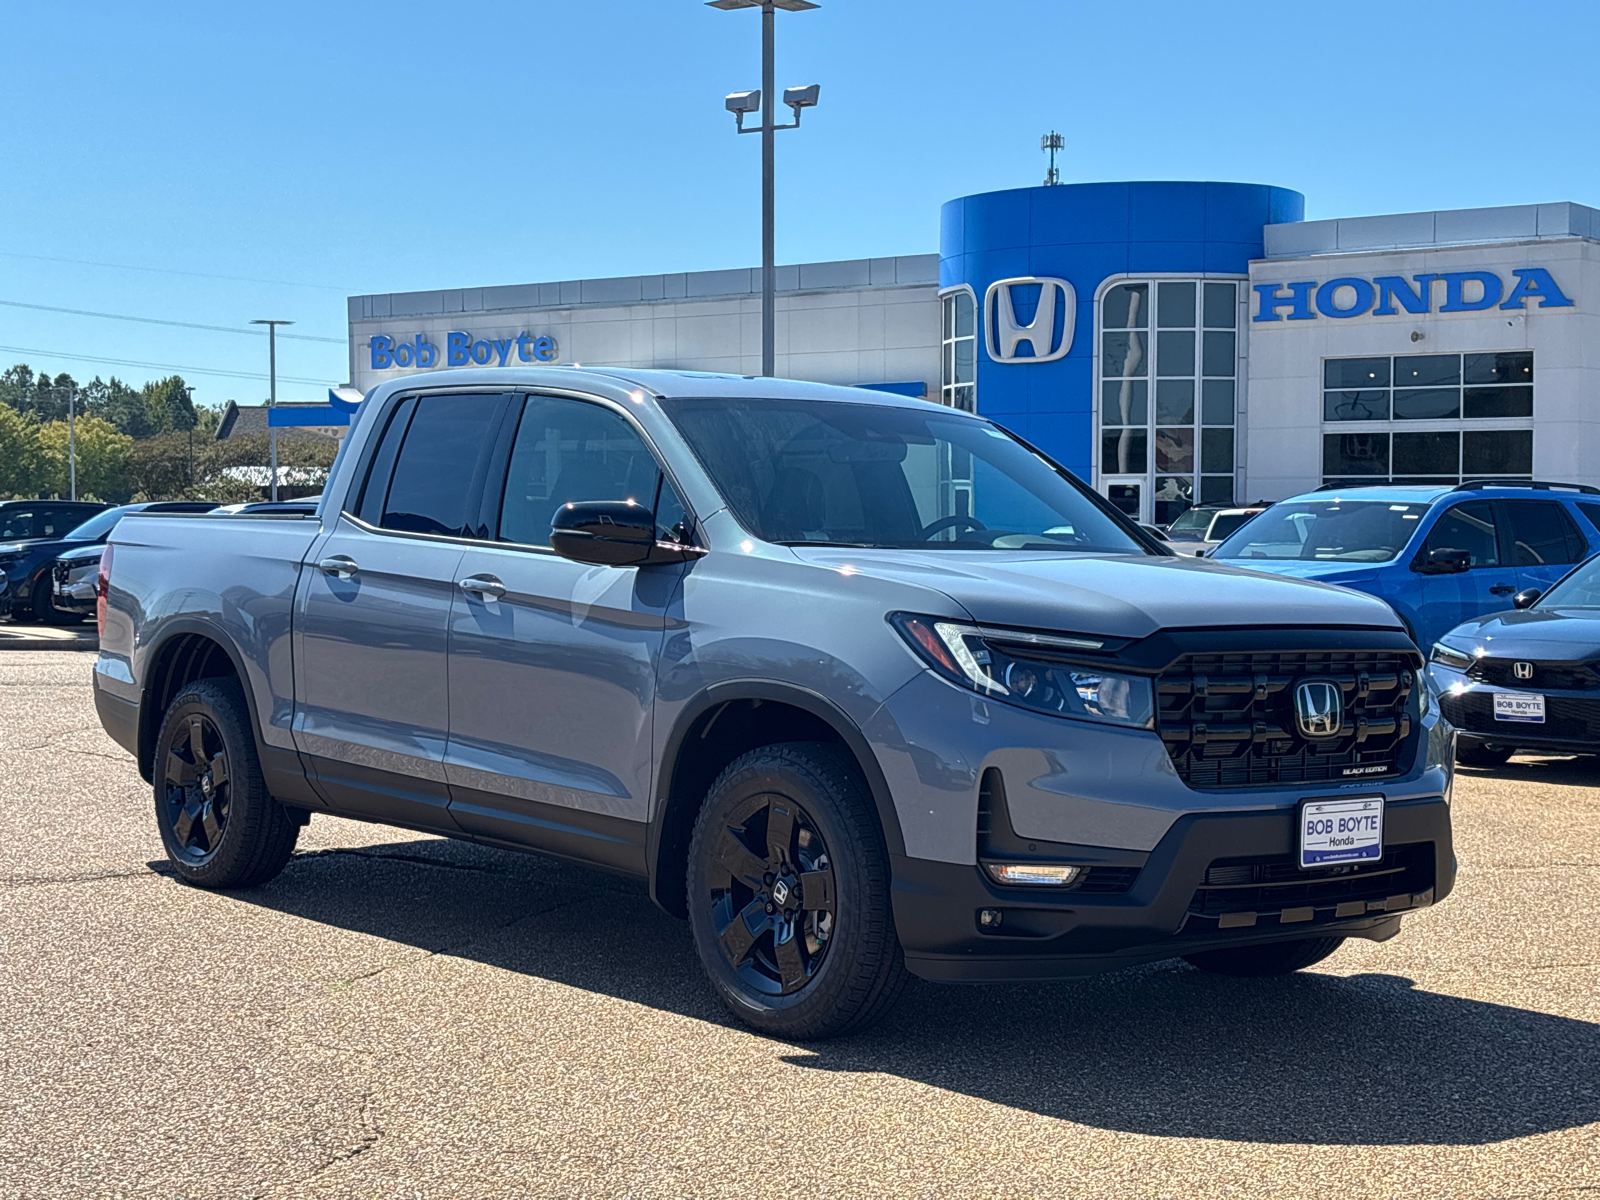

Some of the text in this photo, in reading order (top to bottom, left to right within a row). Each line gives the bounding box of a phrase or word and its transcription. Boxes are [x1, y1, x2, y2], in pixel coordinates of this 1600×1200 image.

[1252, 267, 1575, 322] HONDA
[370, 330, 556, 370] Bob Boyte
[1306, 815, 1379, 835] BOB BOYTE
[1329, 835, 1355, 847] Honda
